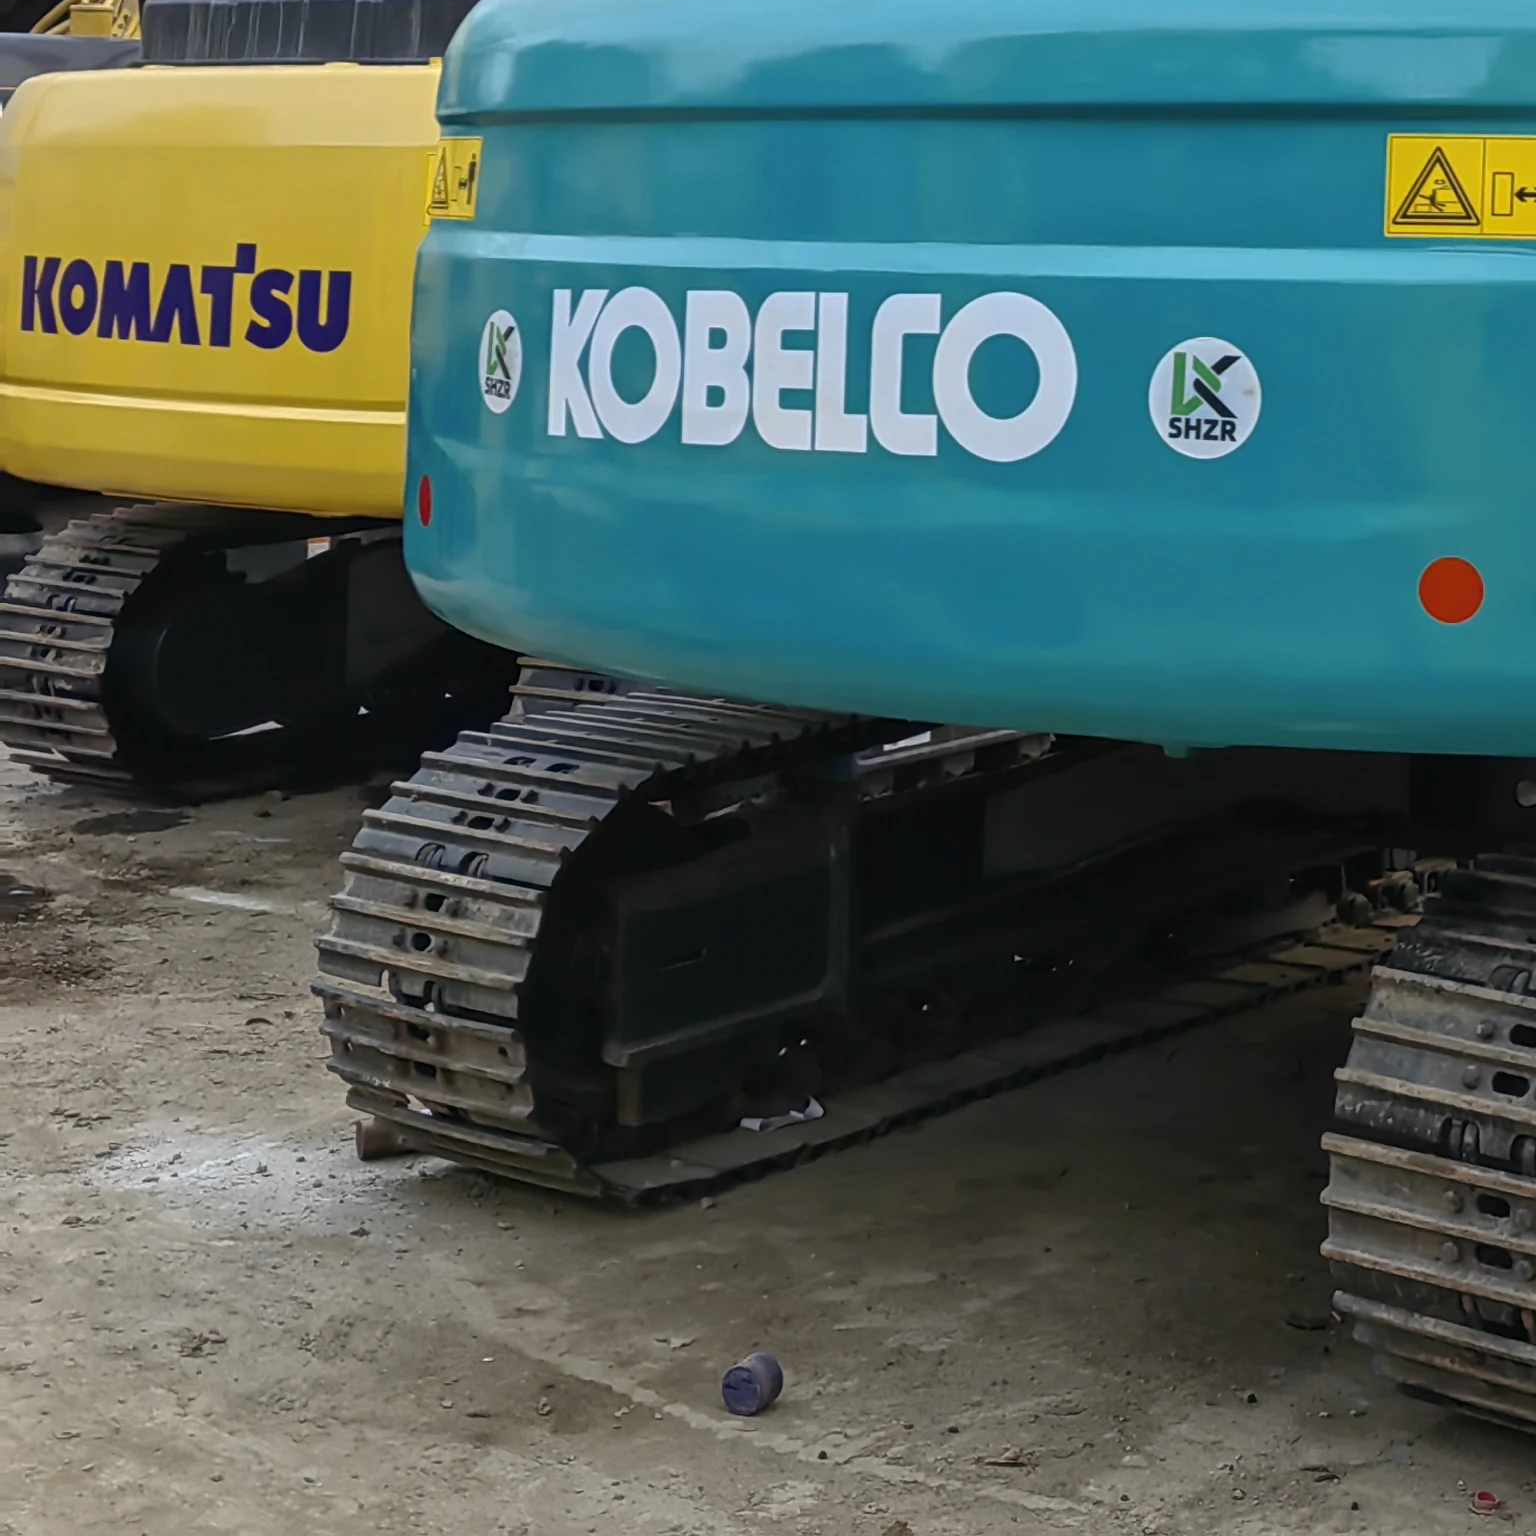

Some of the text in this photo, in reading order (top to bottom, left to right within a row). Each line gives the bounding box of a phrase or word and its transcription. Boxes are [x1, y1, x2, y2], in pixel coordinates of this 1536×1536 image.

[20, 242, 353, 353] KOMATSU
[485, 376, 511, 400] SHZR
[547, 286, 1078, 462] KOBELCO
[1168, 416, 1238, 442] SHZR
